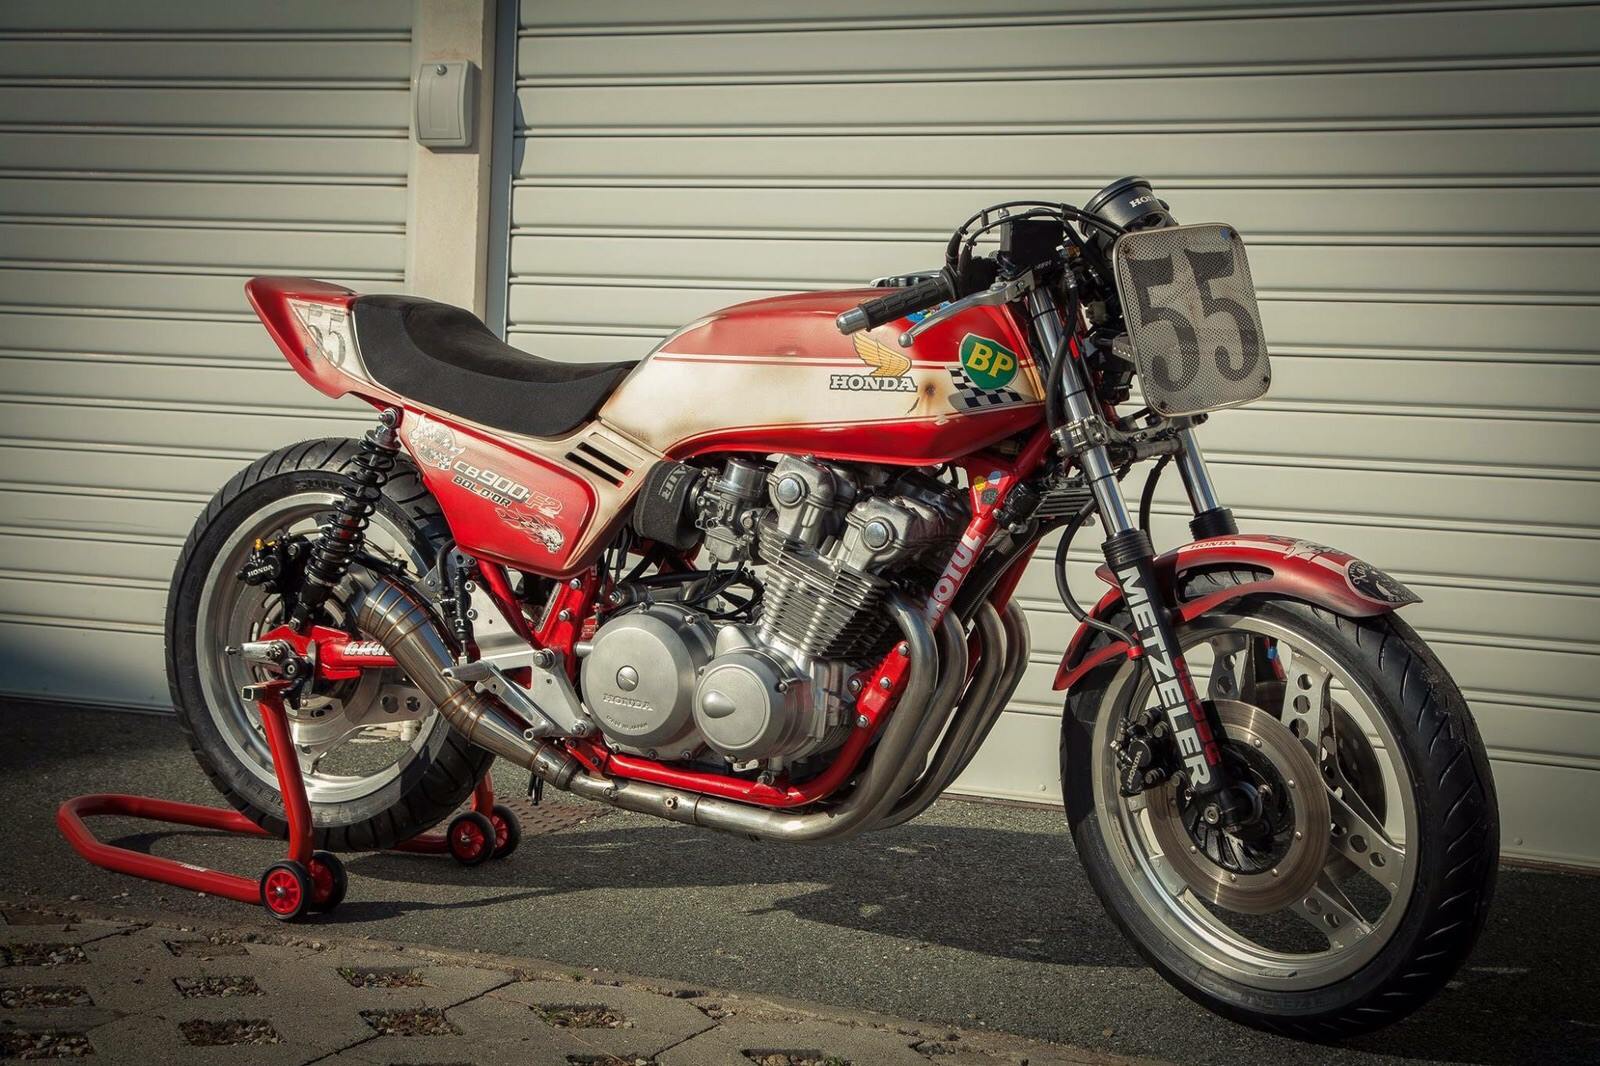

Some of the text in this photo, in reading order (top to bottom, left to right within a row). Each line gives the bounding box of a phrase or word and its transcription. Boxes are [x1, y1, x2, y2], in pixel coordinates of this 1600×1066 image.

[1125, 249, 1260, 393] 55
[966, 342, 1014, 378] BP
[830, 375, 918, 393] HONDA
[1190, 540, 1236, 550] HONDA
[247, 564, 274, 577] HONDA
[1117, 566, 1212, 788] METZELER
[603, 693, 654, 711] HONDA
